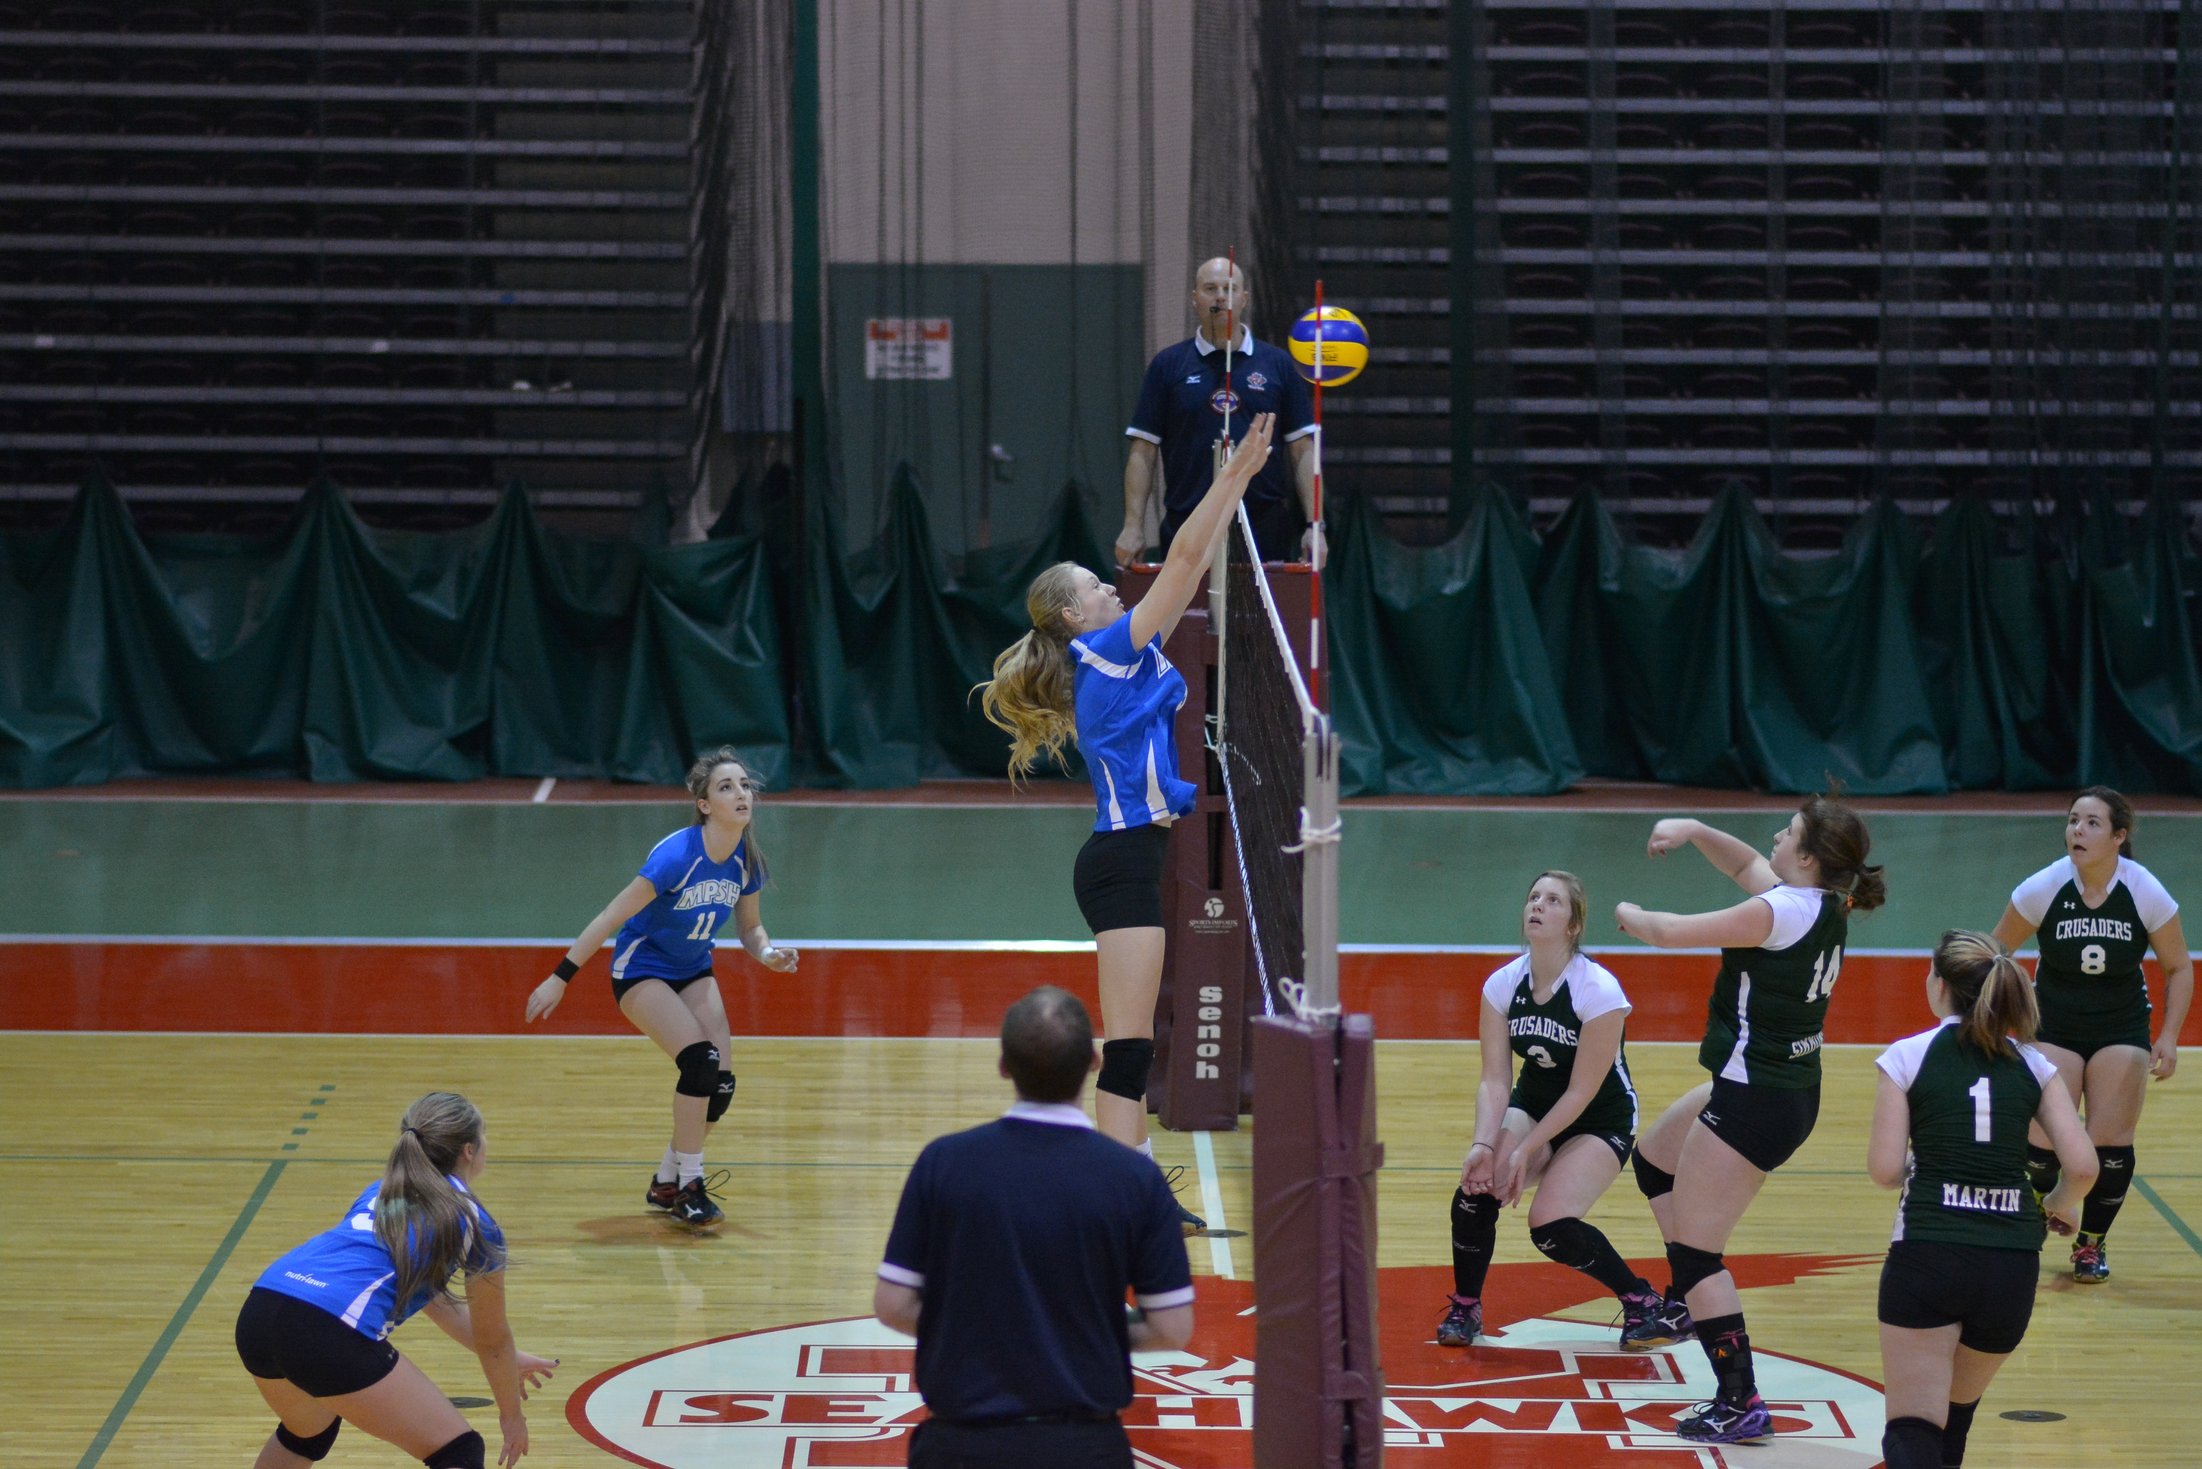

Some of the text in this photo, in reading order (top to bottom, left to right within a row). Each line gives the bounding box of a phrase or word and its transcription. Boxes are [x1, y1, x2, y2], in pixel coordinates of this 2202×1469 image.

[686, 912, 716, 940] 11
[2056, 917, 2133, 941] CRUSADERS
[1805, 945, 1841, 1003] 14
[2081, 944, 2106, 975] 8
[1195, 986, 1223, 1079] senoh
[1508, 1015, 1579, 1046] RUSADERS
[1969, 1077, 1991, 1142] 1
[1942, 1183, 2021, 1212] MARTIN
